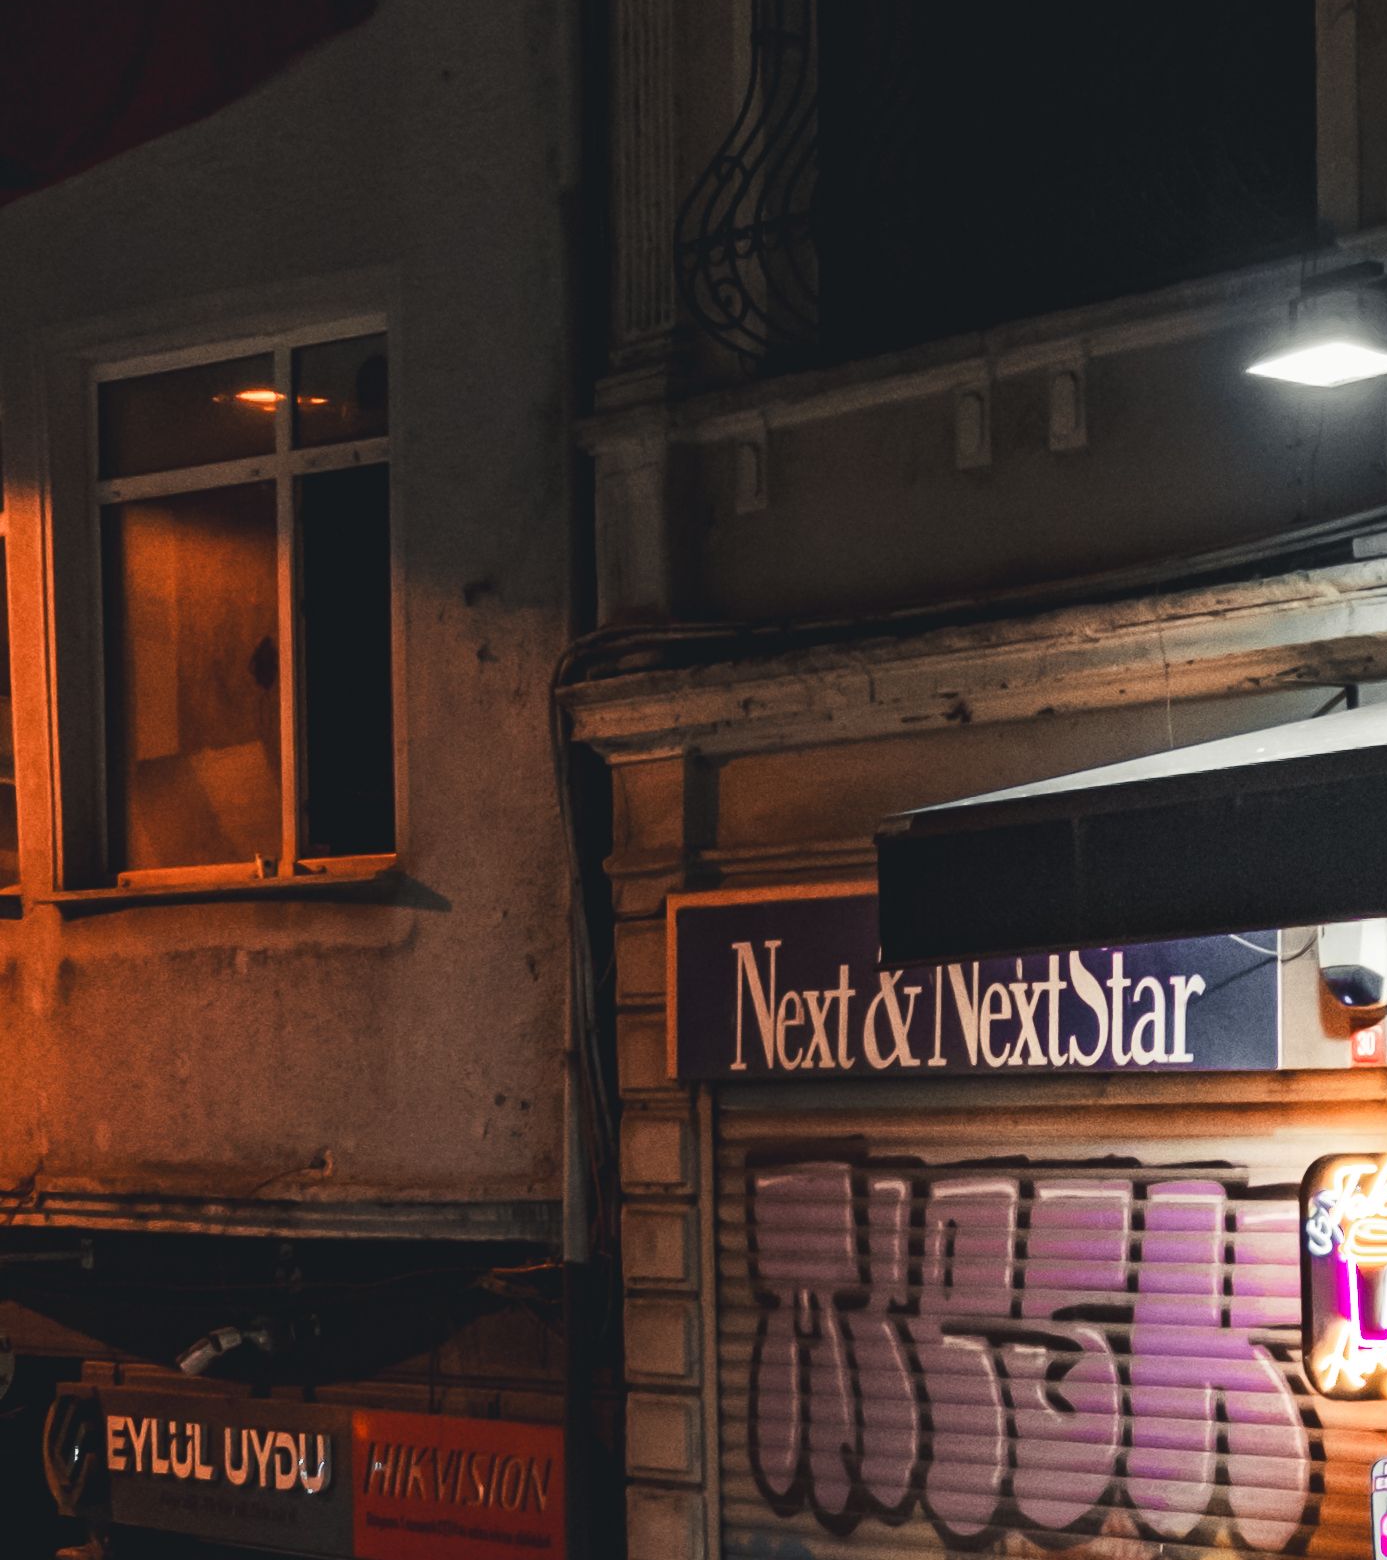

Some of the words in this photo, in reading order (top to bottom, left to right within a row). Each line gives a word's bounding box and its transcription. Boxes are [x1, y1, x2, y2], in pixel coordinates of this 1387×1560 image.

[730, 940, 857, 1072] Next
[863, 968, 922, 1068] &
[1357, 1030, 1376, 1056] 30
[106, 1414, 215, 1481] EYLÜL
[223, 1425, 330, 1494] UYDU
[363, 1441, 553, 1513] HIKVISION
